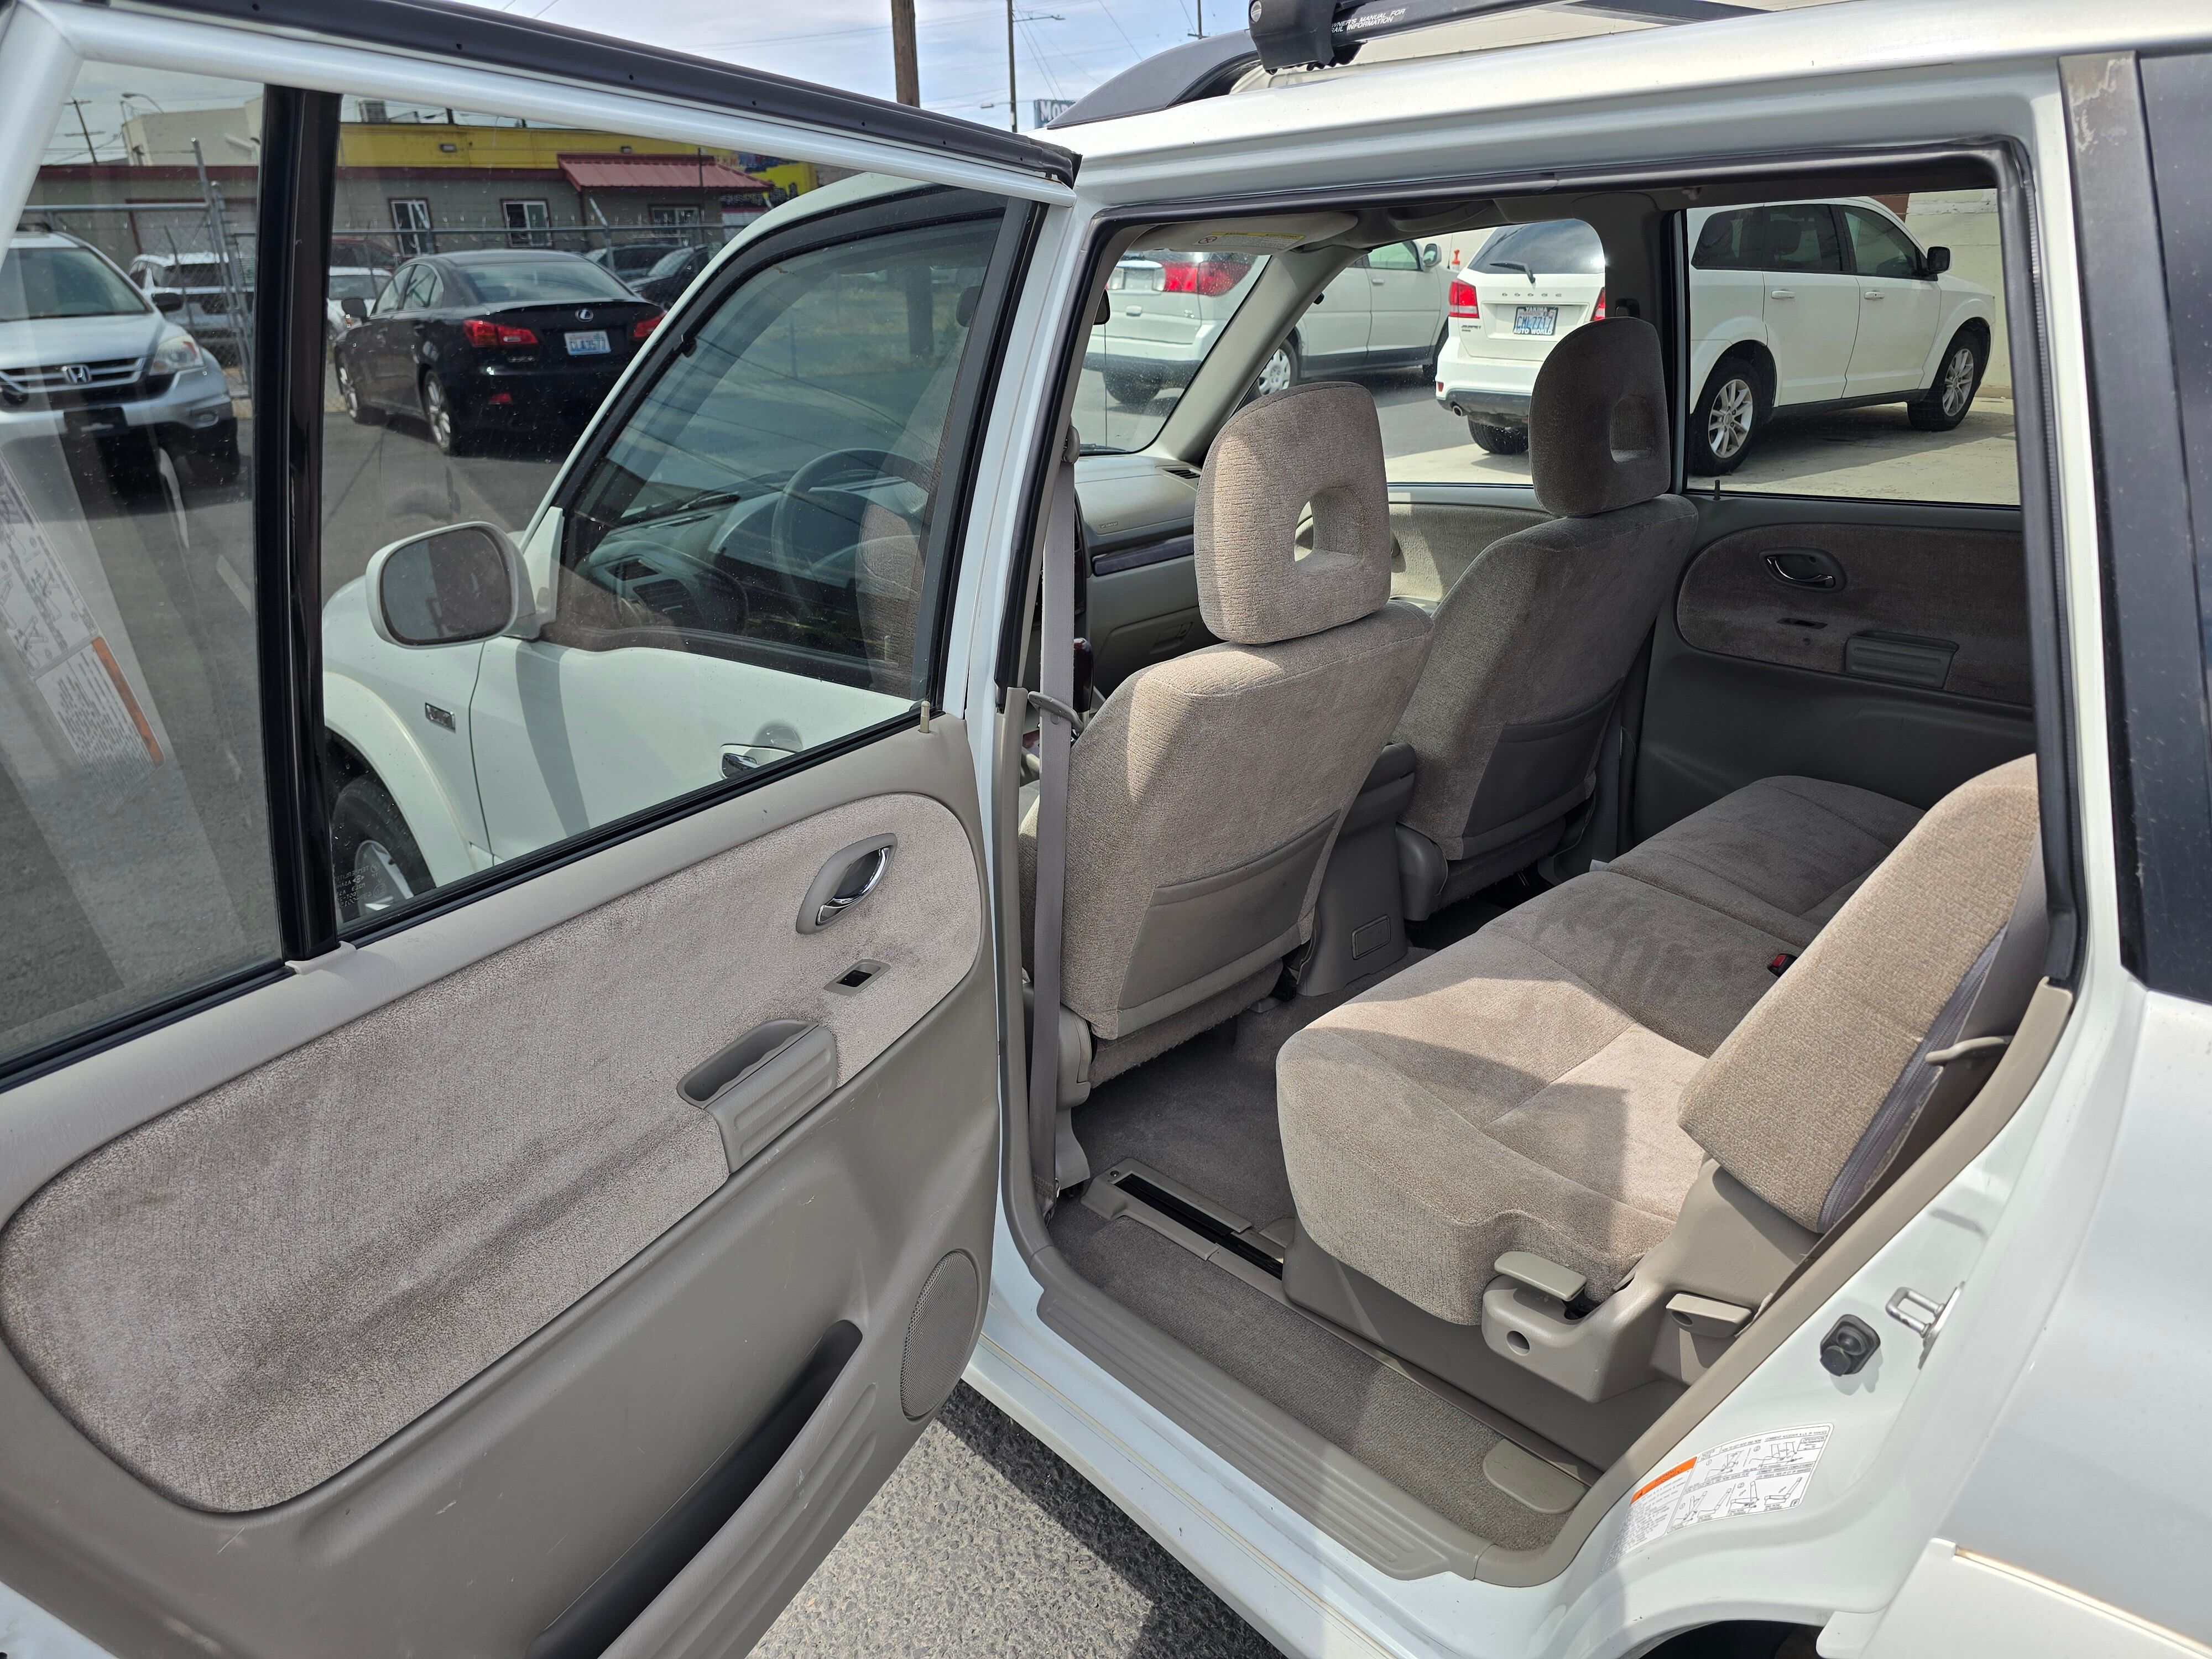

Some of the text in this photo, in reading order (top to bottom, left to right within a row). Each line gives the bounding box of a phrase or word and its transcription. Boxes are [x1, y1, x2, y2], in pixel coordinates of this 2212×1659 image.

[1332, 8, 1406, 28] WNER'S MANUAL FOR
[1347, 16, 1394, 31] INFORMATION
